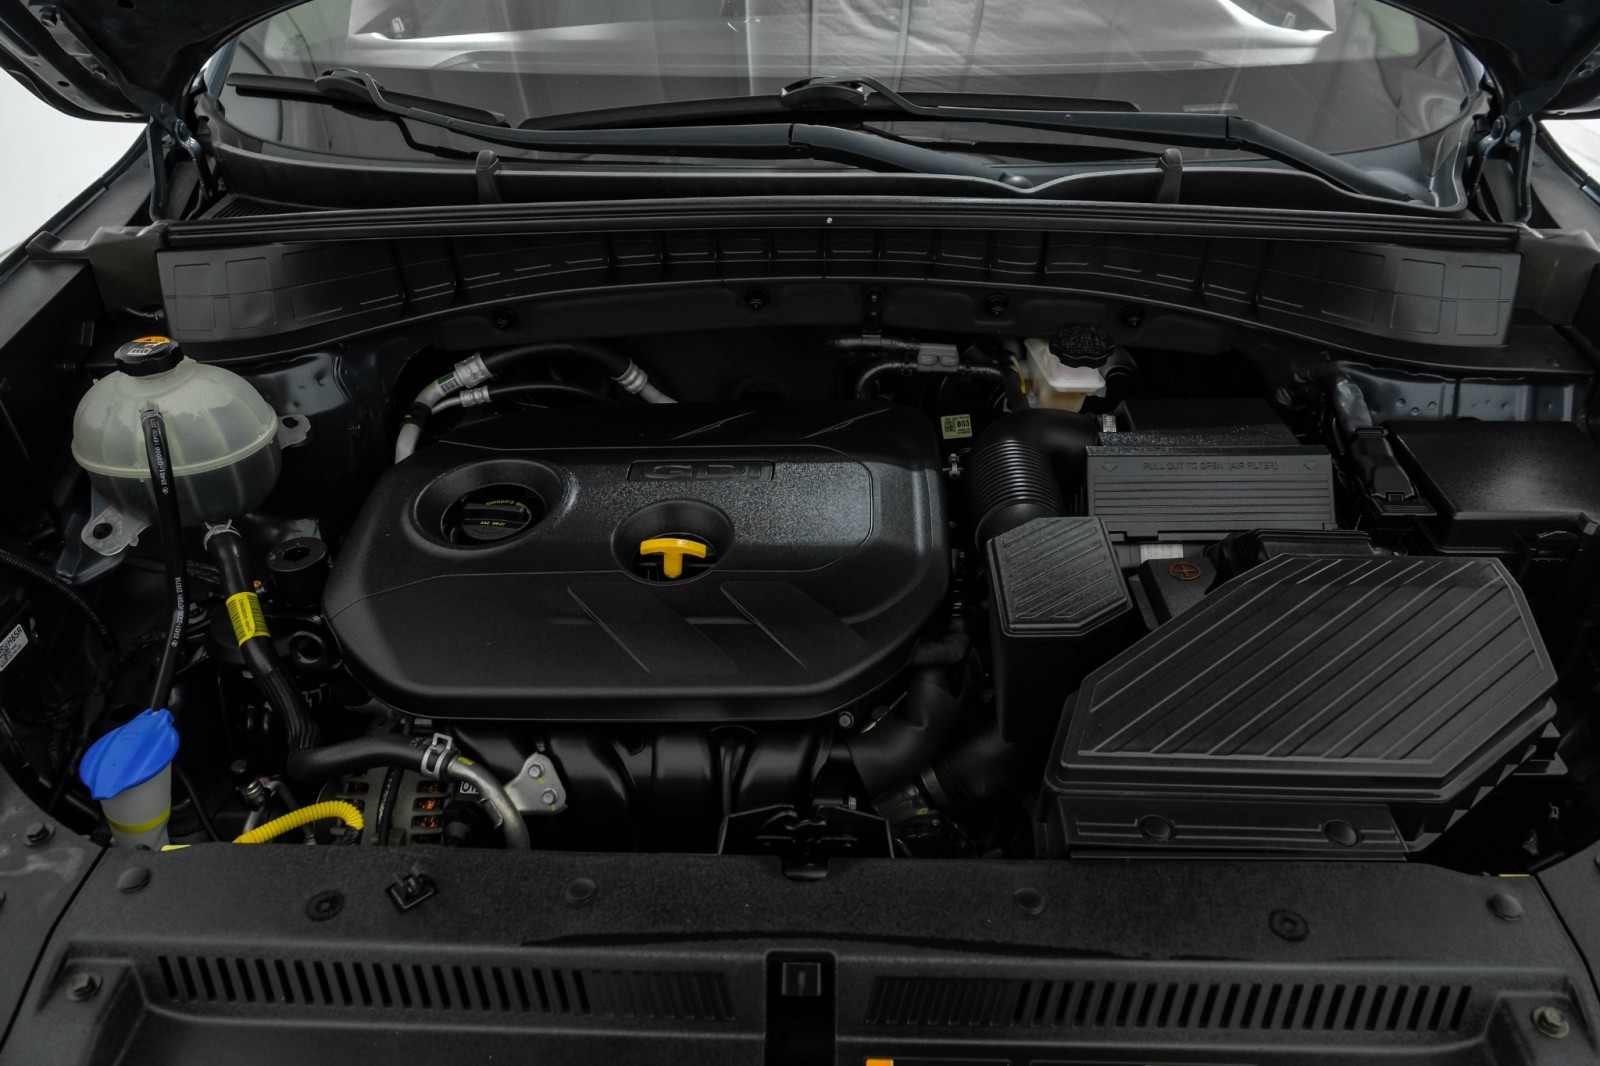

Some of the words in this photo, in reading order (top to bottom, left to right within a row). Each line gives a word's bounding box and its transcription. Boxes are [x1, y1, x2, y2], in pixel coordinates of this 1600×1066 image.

[956, 420, 970, 428] B03
[1167, 462, 1184, 470] OUT
[1186, 462, 1198, 470] TO
